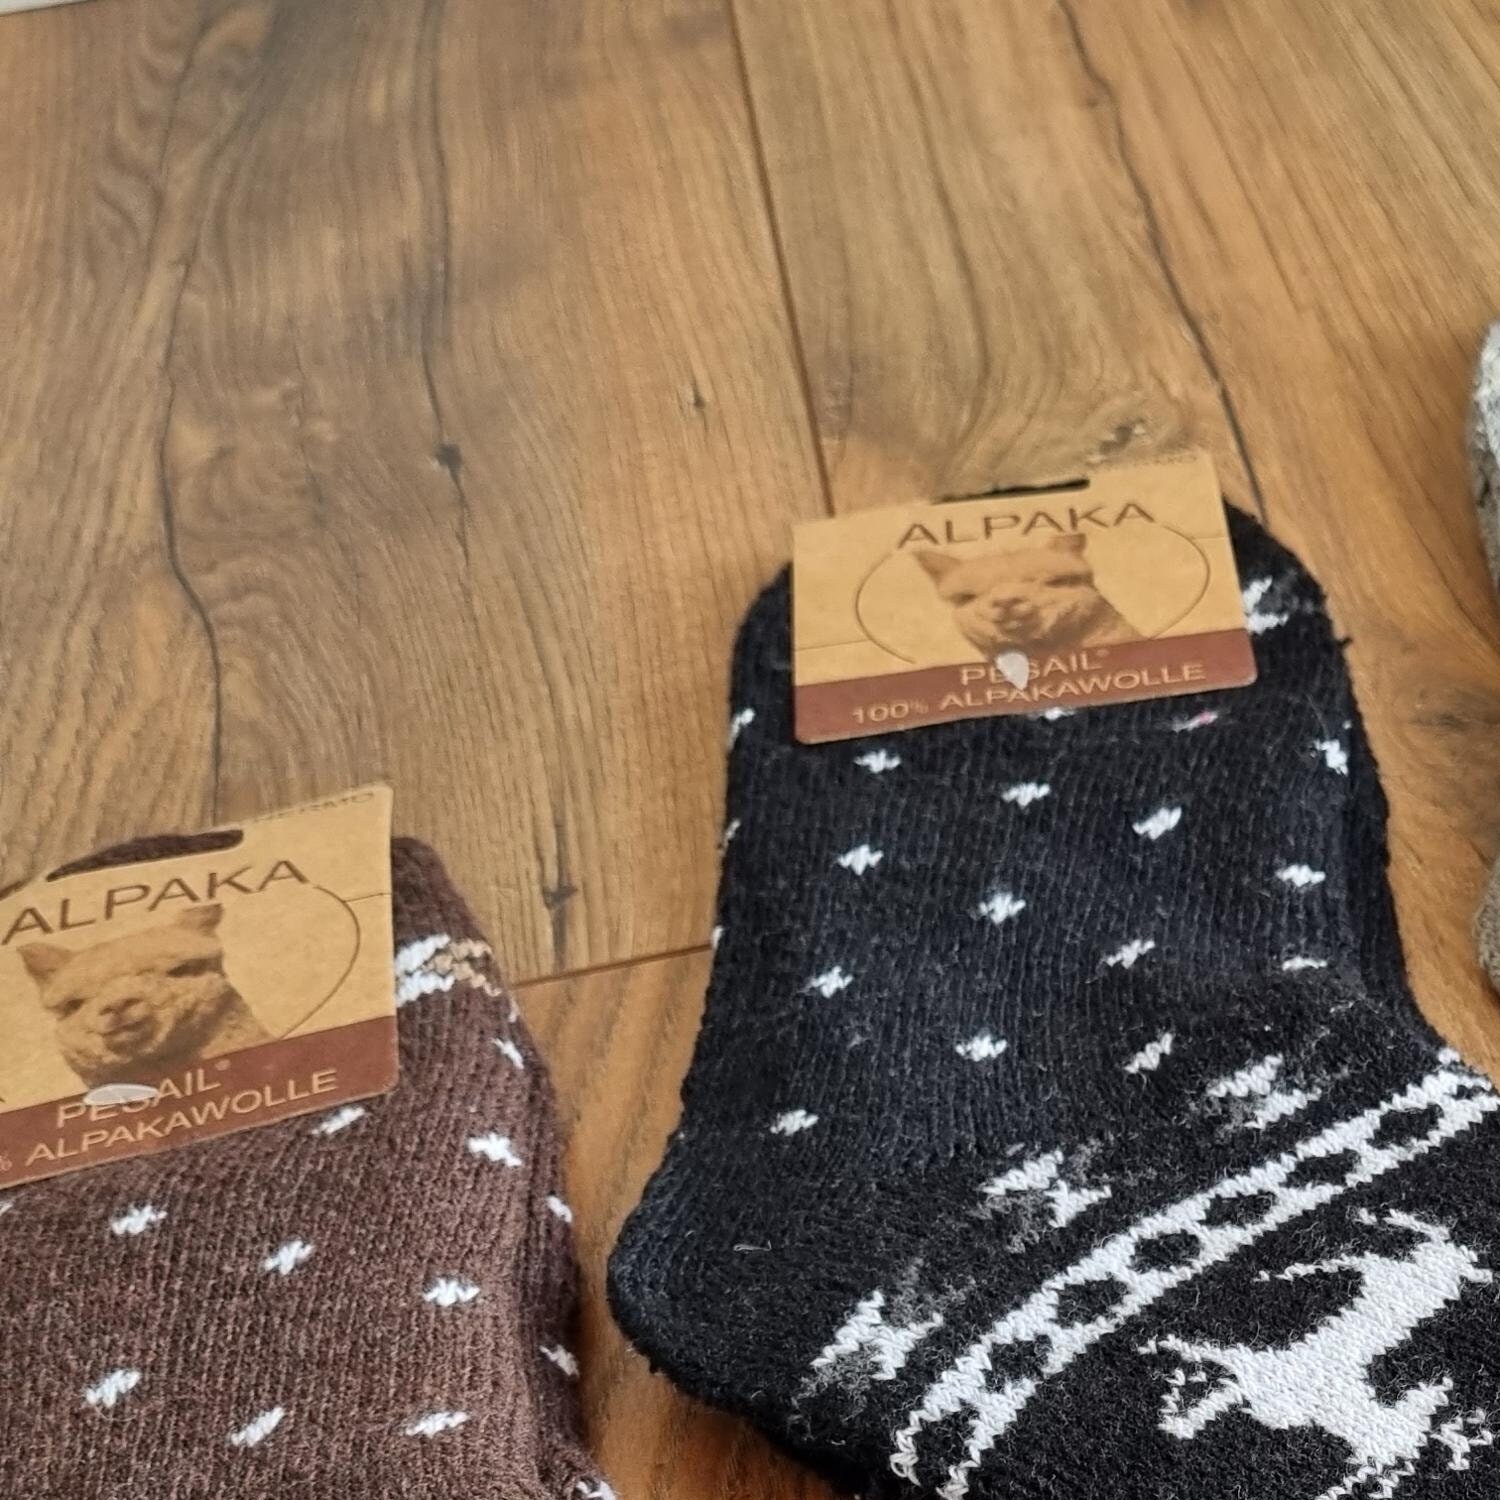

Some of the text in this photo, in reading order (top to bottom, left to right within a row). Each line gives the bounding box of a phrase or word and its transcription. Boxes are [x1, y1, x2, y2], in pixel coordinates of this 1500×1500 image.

[896, 501, 1157, 551] ALPAKA
[851, 662, 1208, 725] 100% ALPAKAWOLLE
[1, 859, 310, 946] ALPAKA
[24, 1068, 340, 1167] ALPAKAWOLLE
